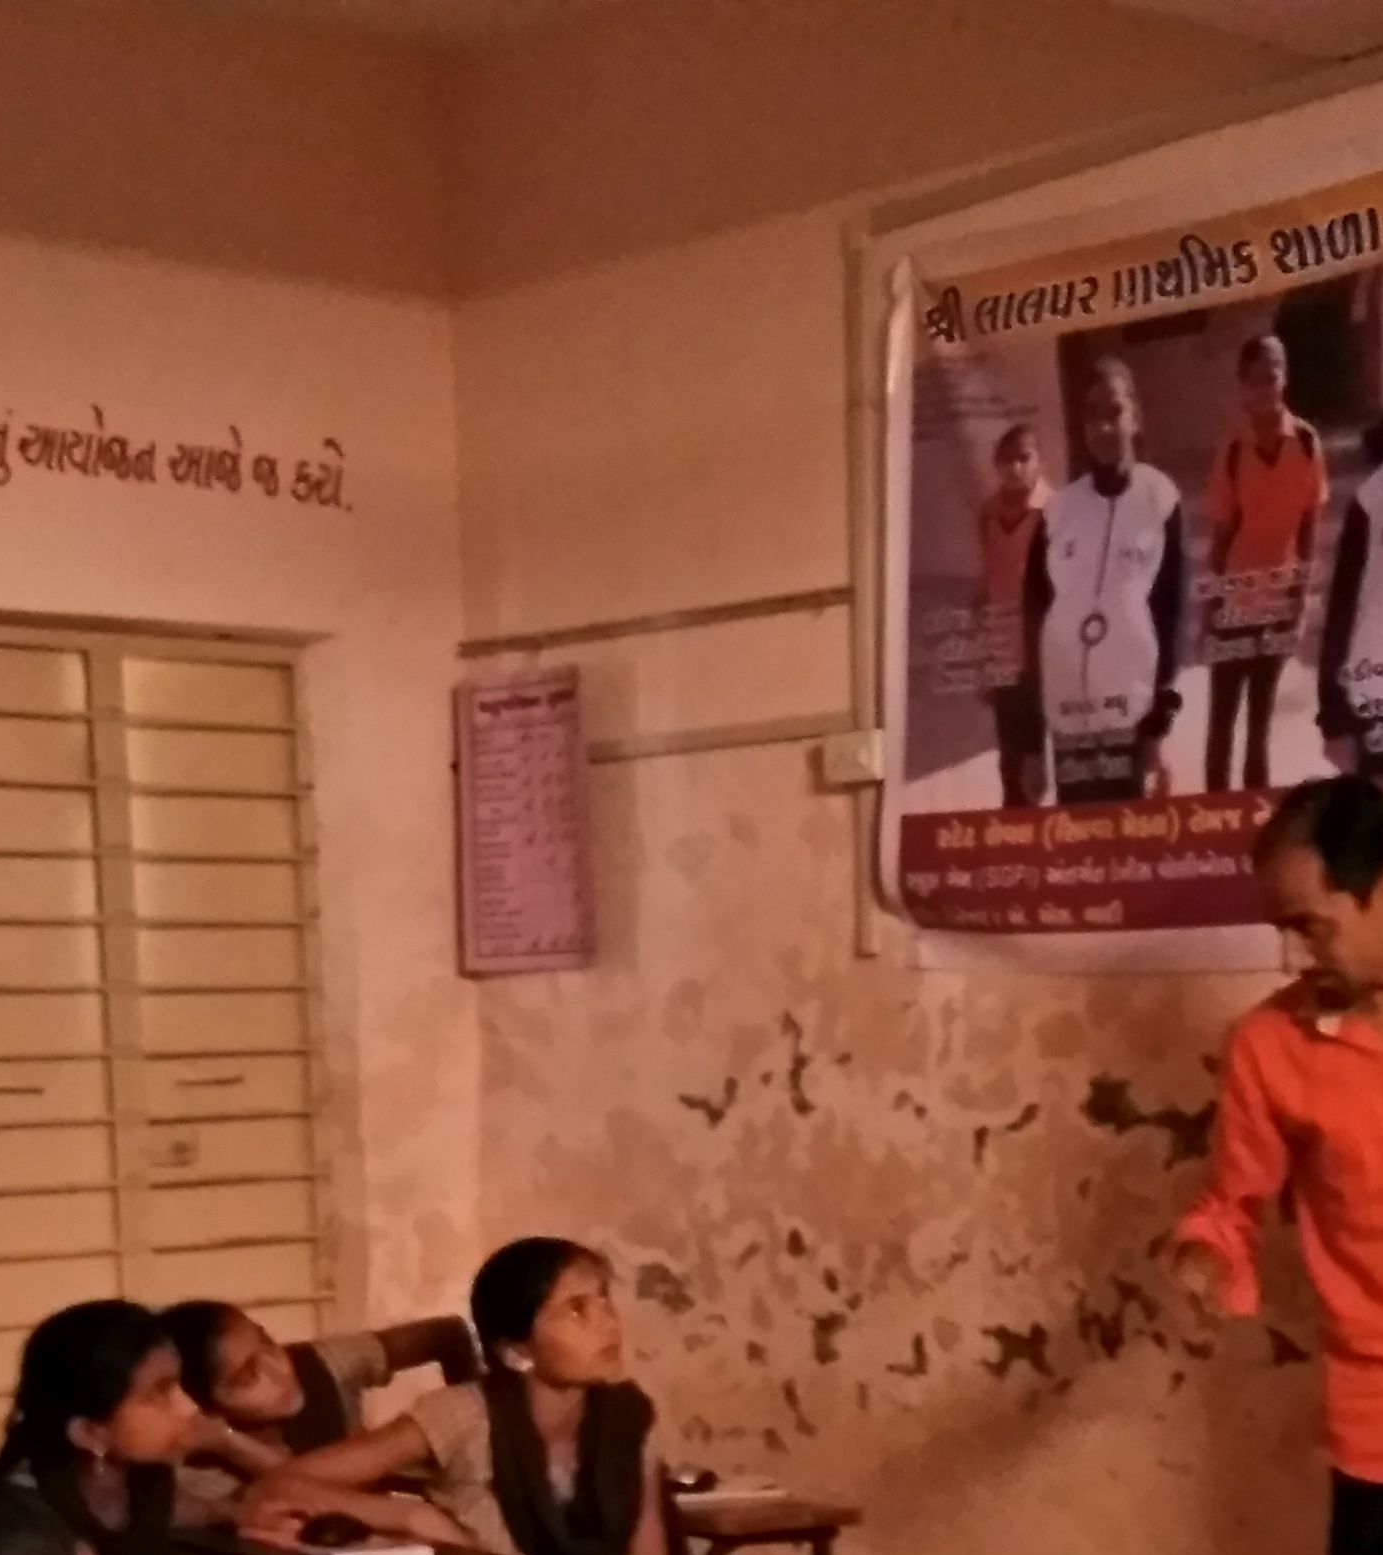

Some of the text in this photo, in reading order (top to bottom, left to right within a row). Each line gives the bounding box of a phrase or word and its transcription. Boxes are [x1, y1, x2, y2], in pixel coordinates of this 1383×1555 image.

[1269, 207, 1382, 275] શાળા
[18, 404, 157, 482] આયોજન
[168, 425, 242, 492] આજે
